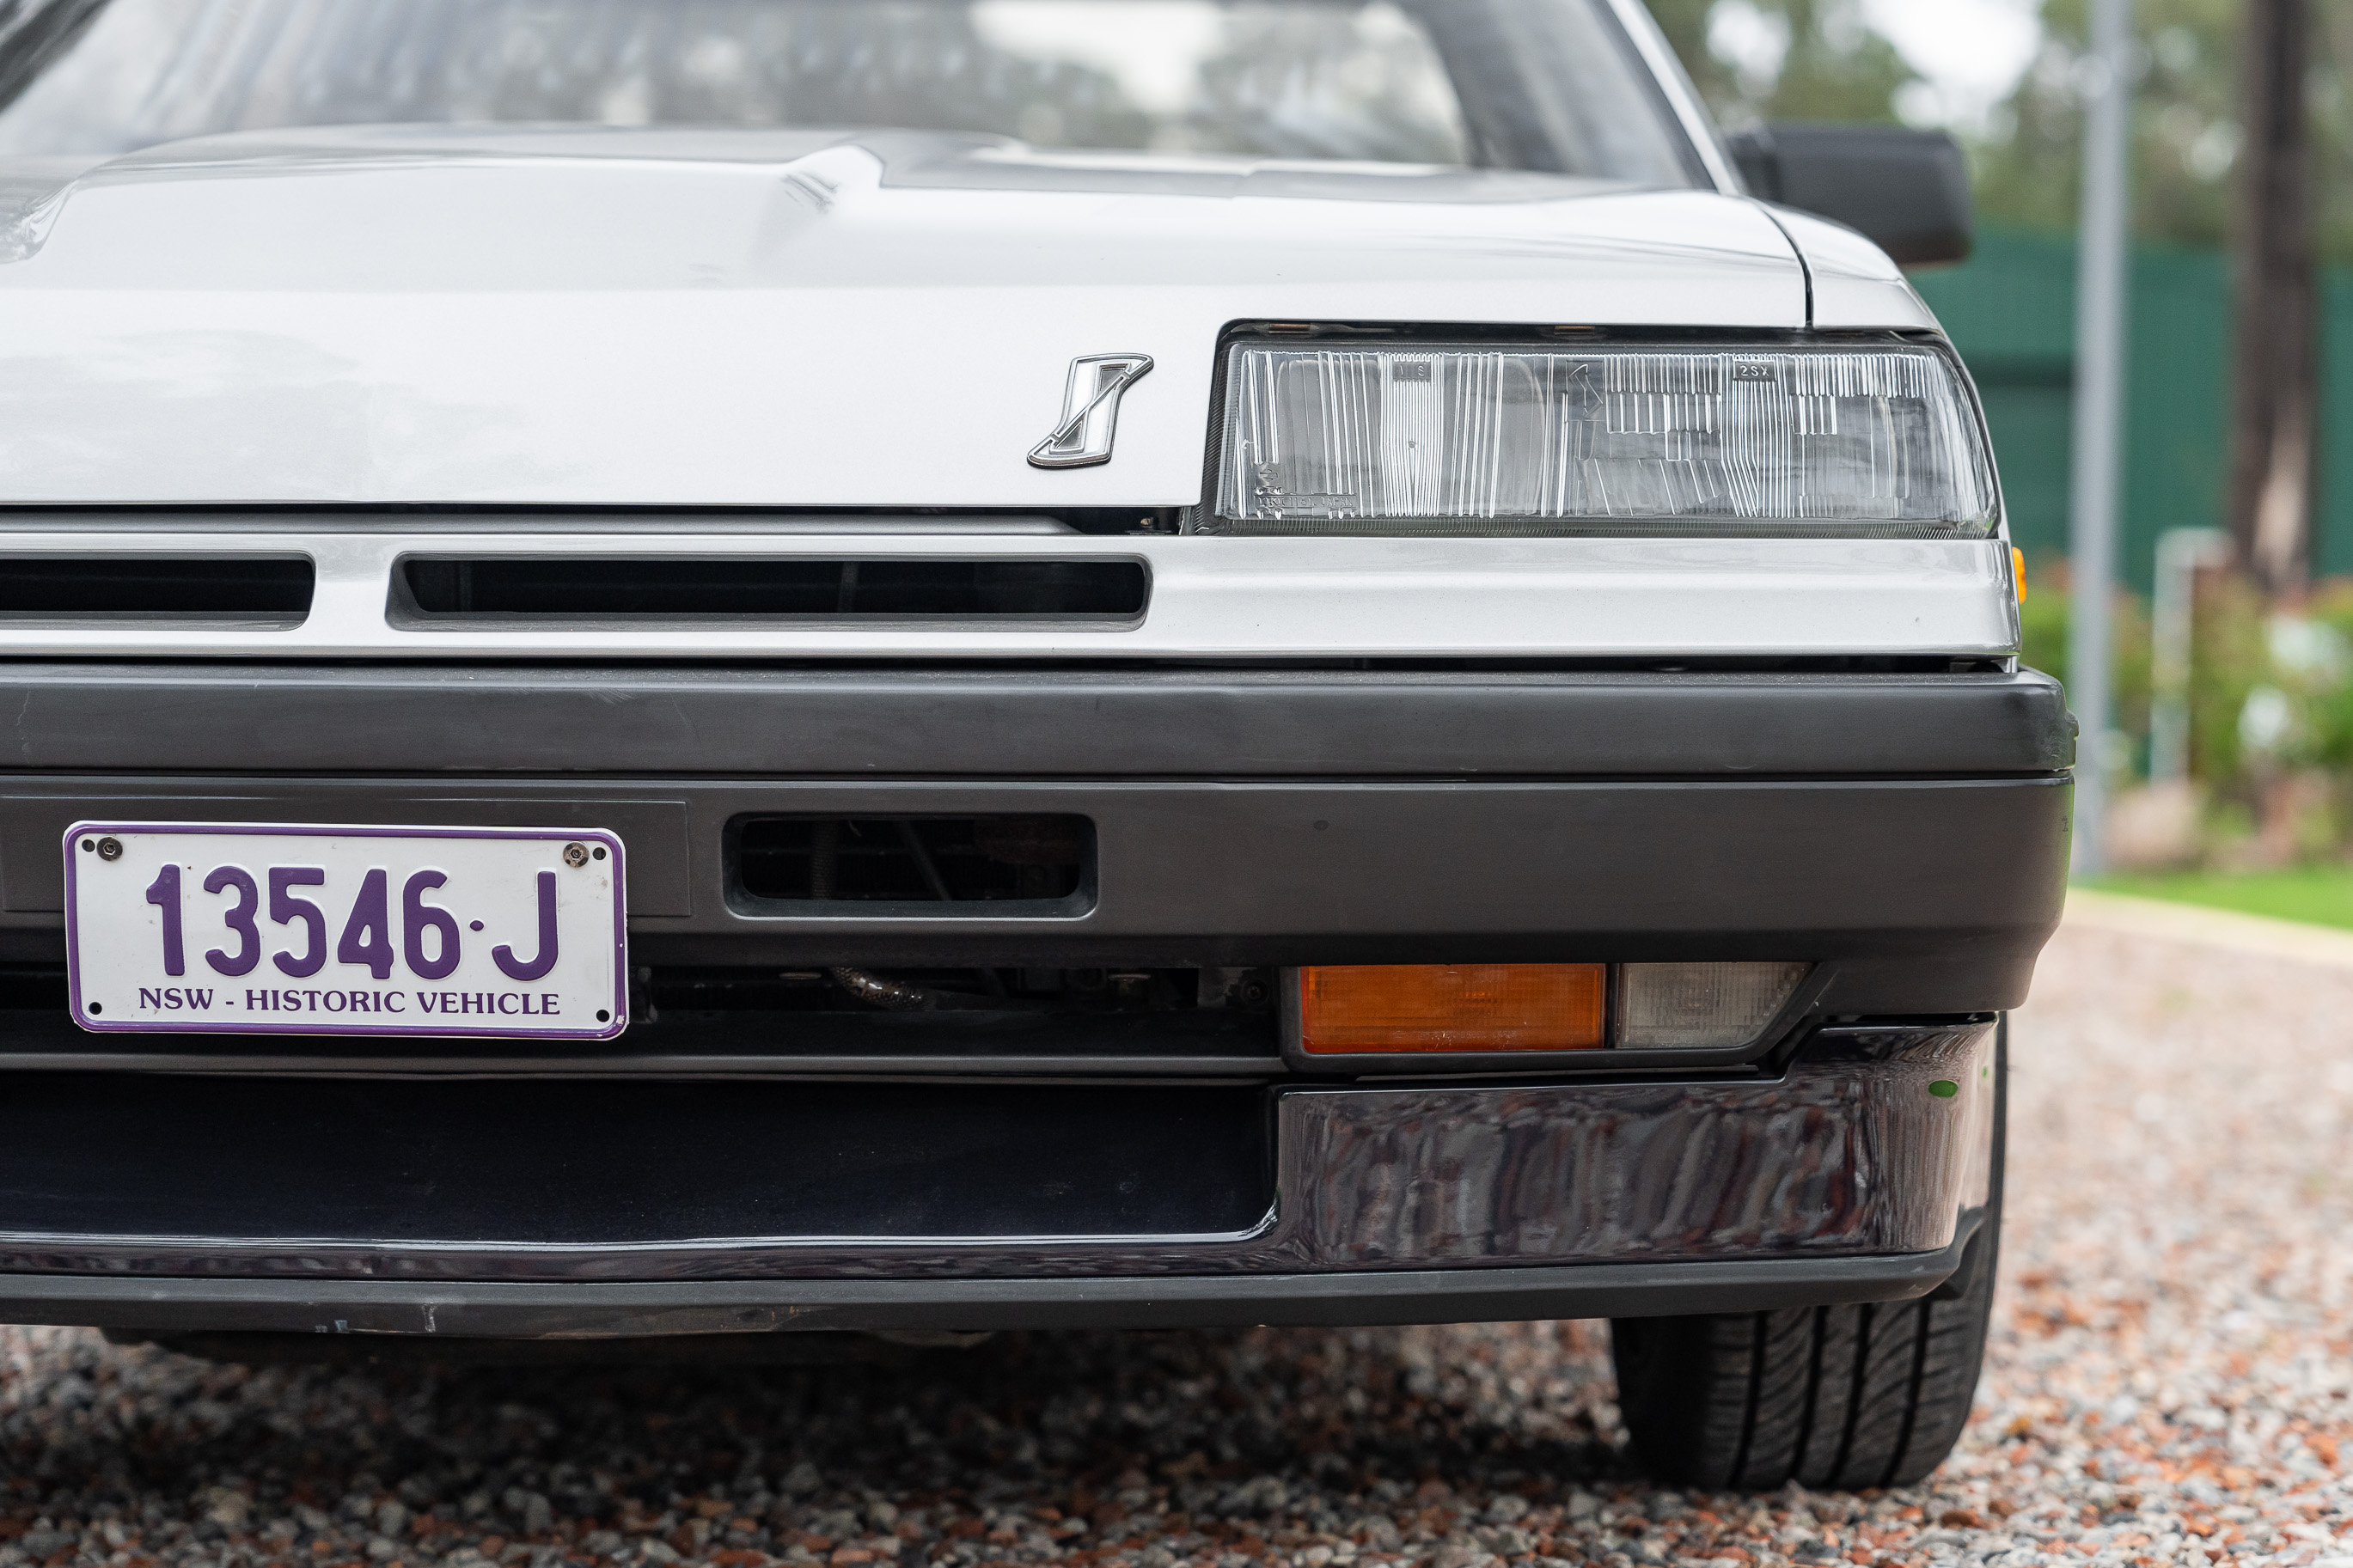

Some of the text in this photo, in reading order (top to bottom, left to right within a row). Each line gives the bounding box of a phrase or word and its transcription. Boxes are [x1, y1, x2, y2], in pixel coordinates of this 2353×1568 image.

[1320, 497, 1354, 507] JAPAN
[139, 988, 213, 1010] NSW
[246, 990, 406, 1012] HISTORIC
[416, 991, 560, 1016] VEHICLE
